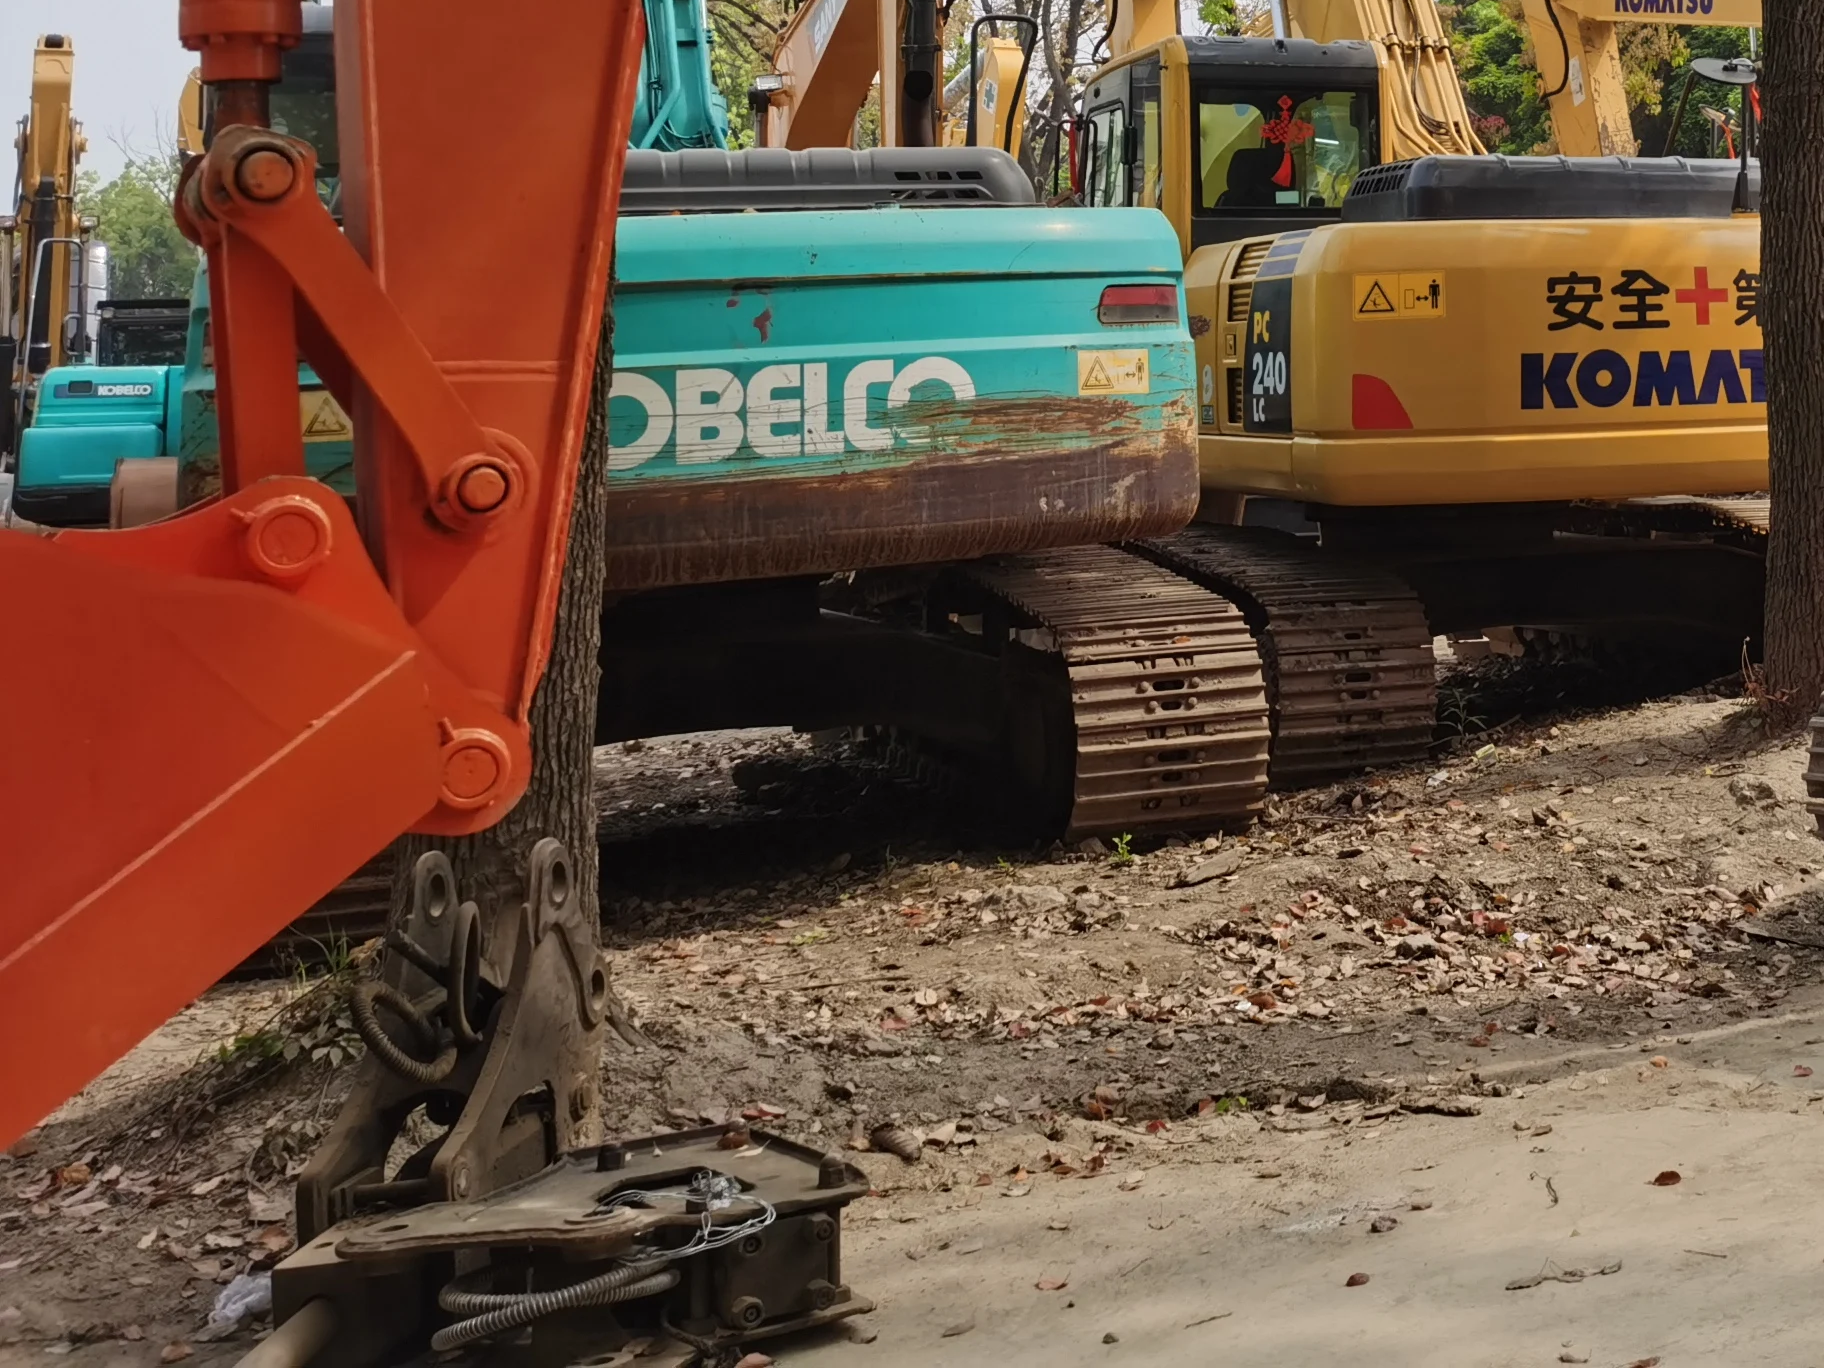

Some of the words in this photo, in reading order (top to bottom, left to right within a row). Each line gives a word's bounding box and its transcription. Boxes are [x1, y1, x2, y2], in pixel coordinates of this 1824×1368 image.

[1253, 310, 1271, 344] PC
[97, 384, 152, 396] KOBELCO
[1252, 351, 1287, 395] 240
[1520, 349, 1768, 410] KOMAT
[607, 356, 977, 470] OBELCO
[1252, 397, 1266, 423] LC
